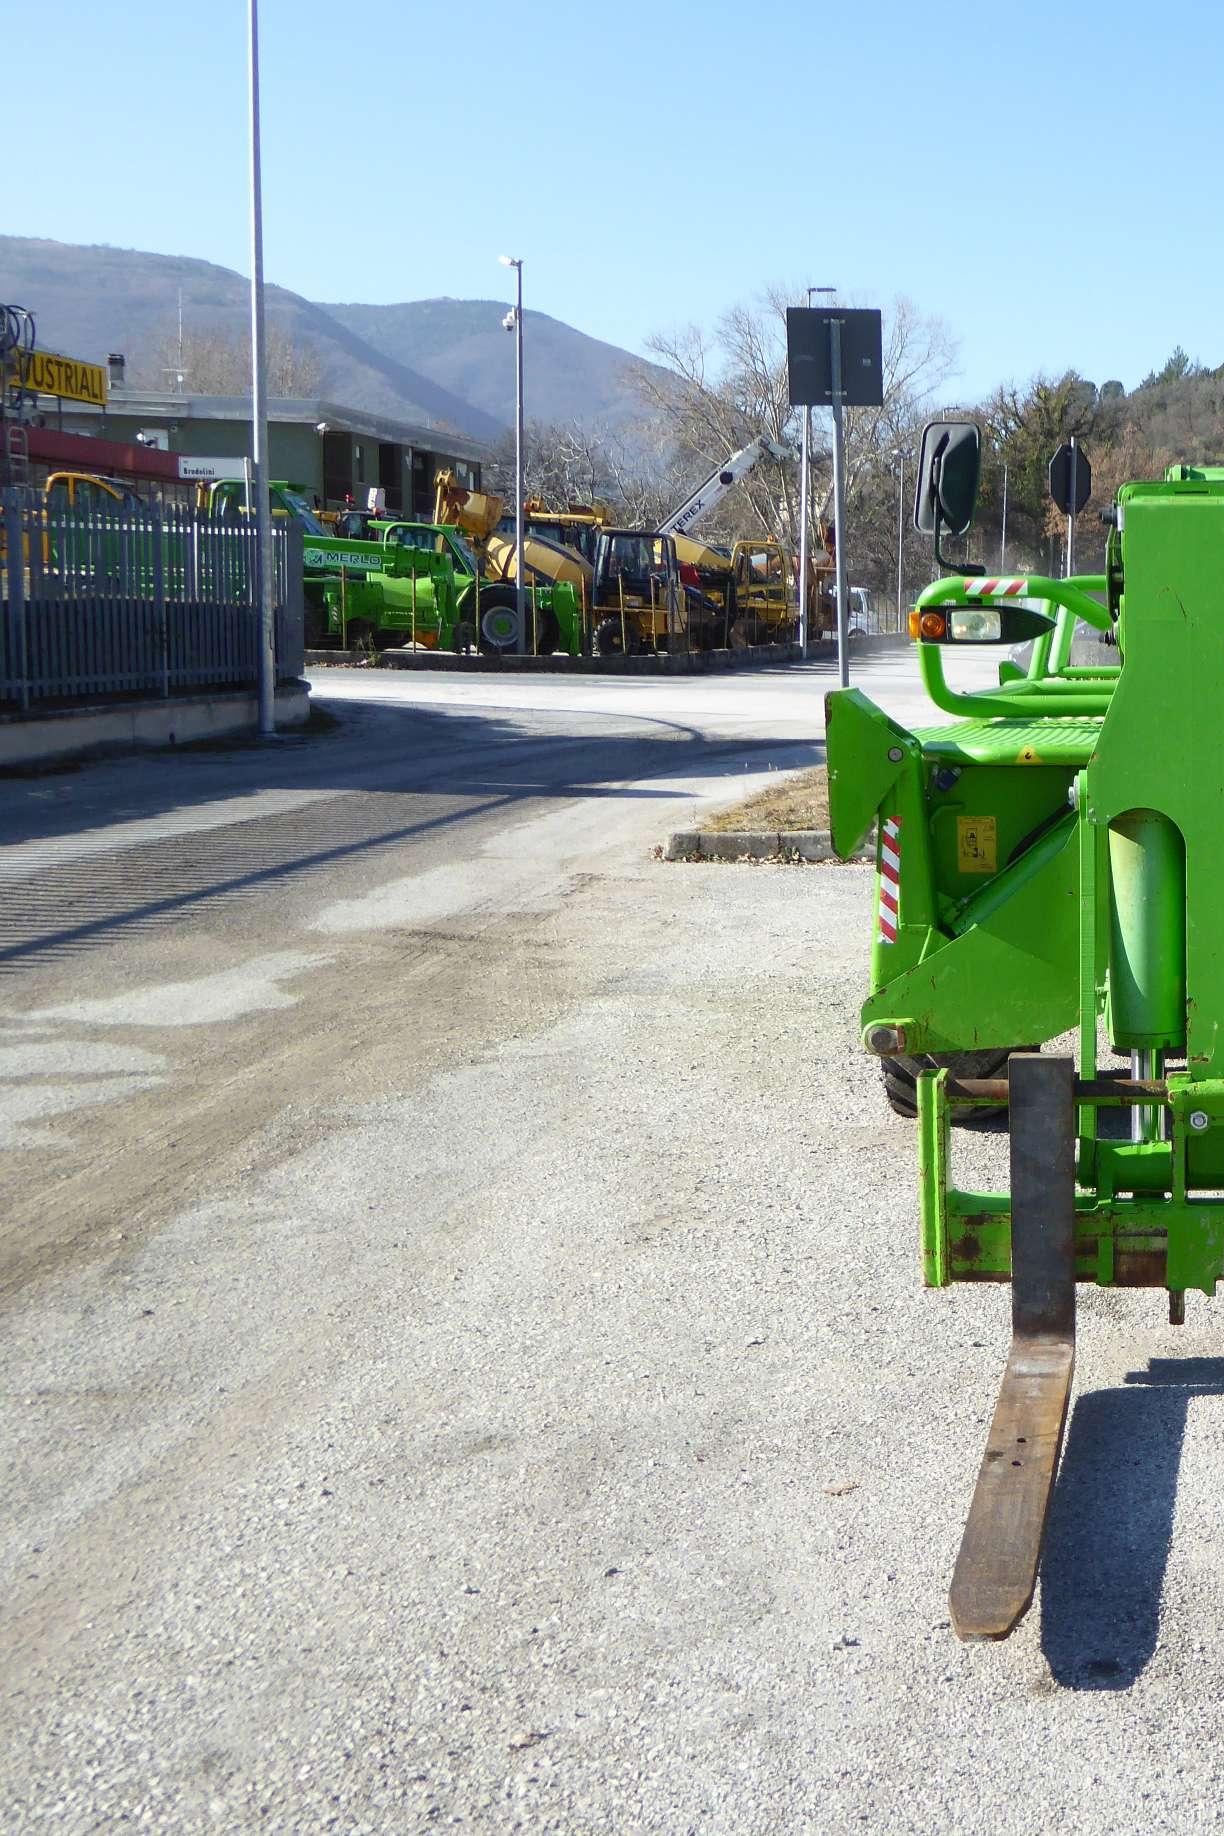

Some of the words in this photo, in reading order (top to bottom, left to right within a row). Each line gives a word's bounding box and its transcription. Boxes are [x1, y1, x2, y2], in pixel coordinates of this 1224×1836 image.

[20, 353, 103, 401] USTRIALI
[671, 500, 706, 533] TEREX
[326, 552, 381, 565] MERLO
